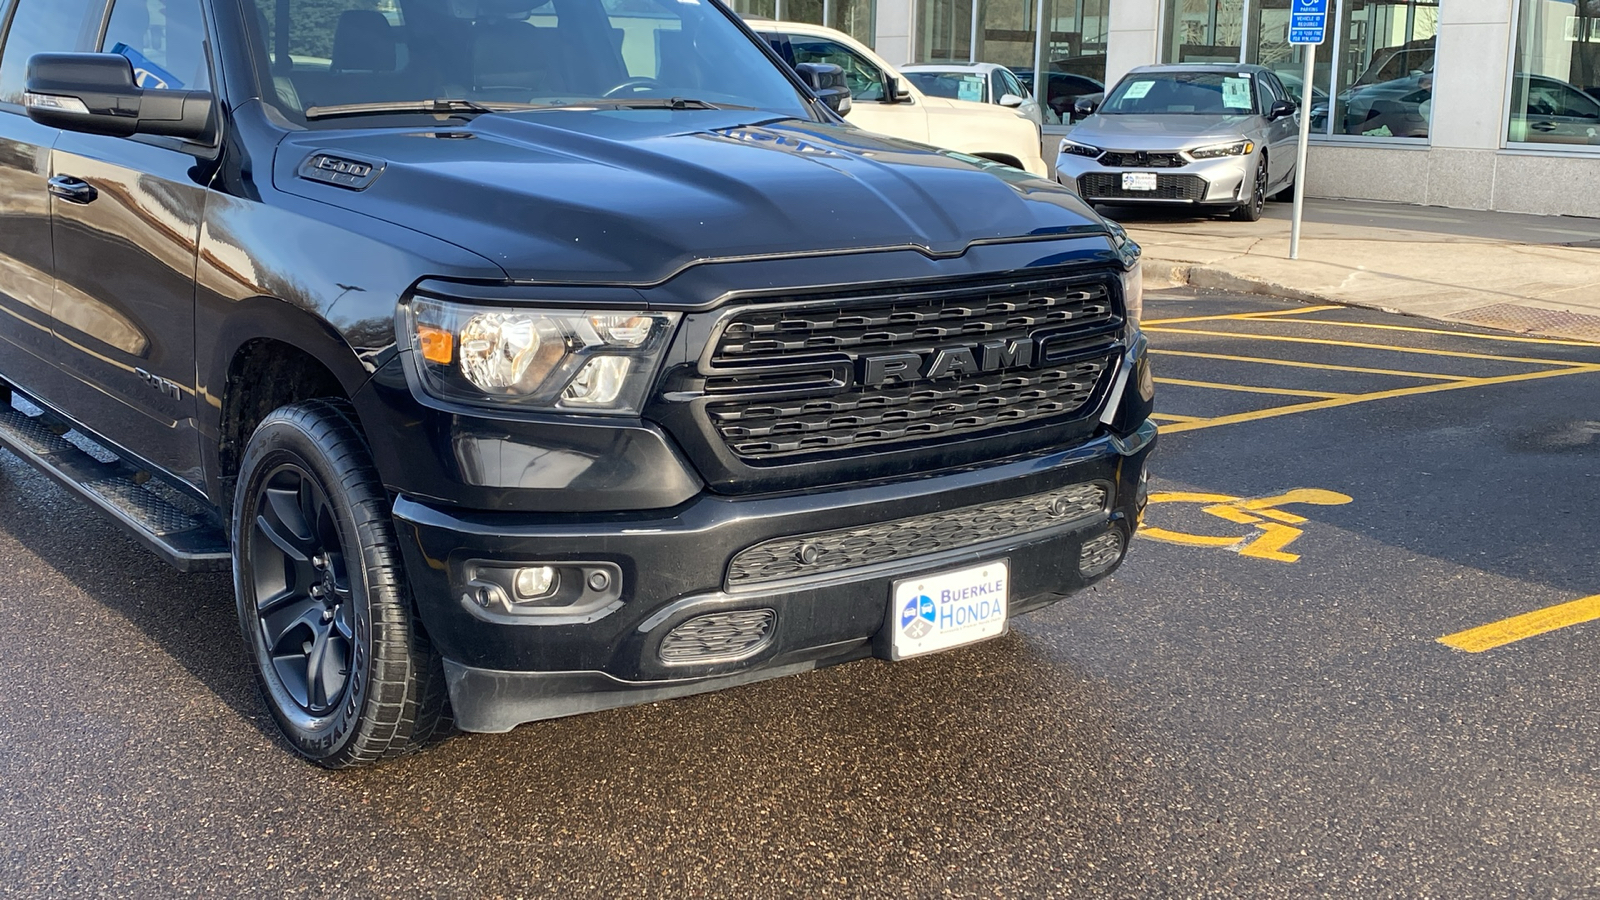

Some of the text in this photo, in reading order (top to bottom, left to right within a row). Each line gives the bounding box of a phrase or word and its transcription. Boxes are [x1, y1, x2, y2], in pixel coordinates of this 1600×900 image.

[312, 156, 372, 177] 1500
[864, 338, 1034, 386] RAM
[135, 366, 181, 401] RAM
[940, 579, 1003, 604] BUERKLE
[940, 598, 1002, 630] HONDA
[299, 611, 366, 751] GOODYEAR
